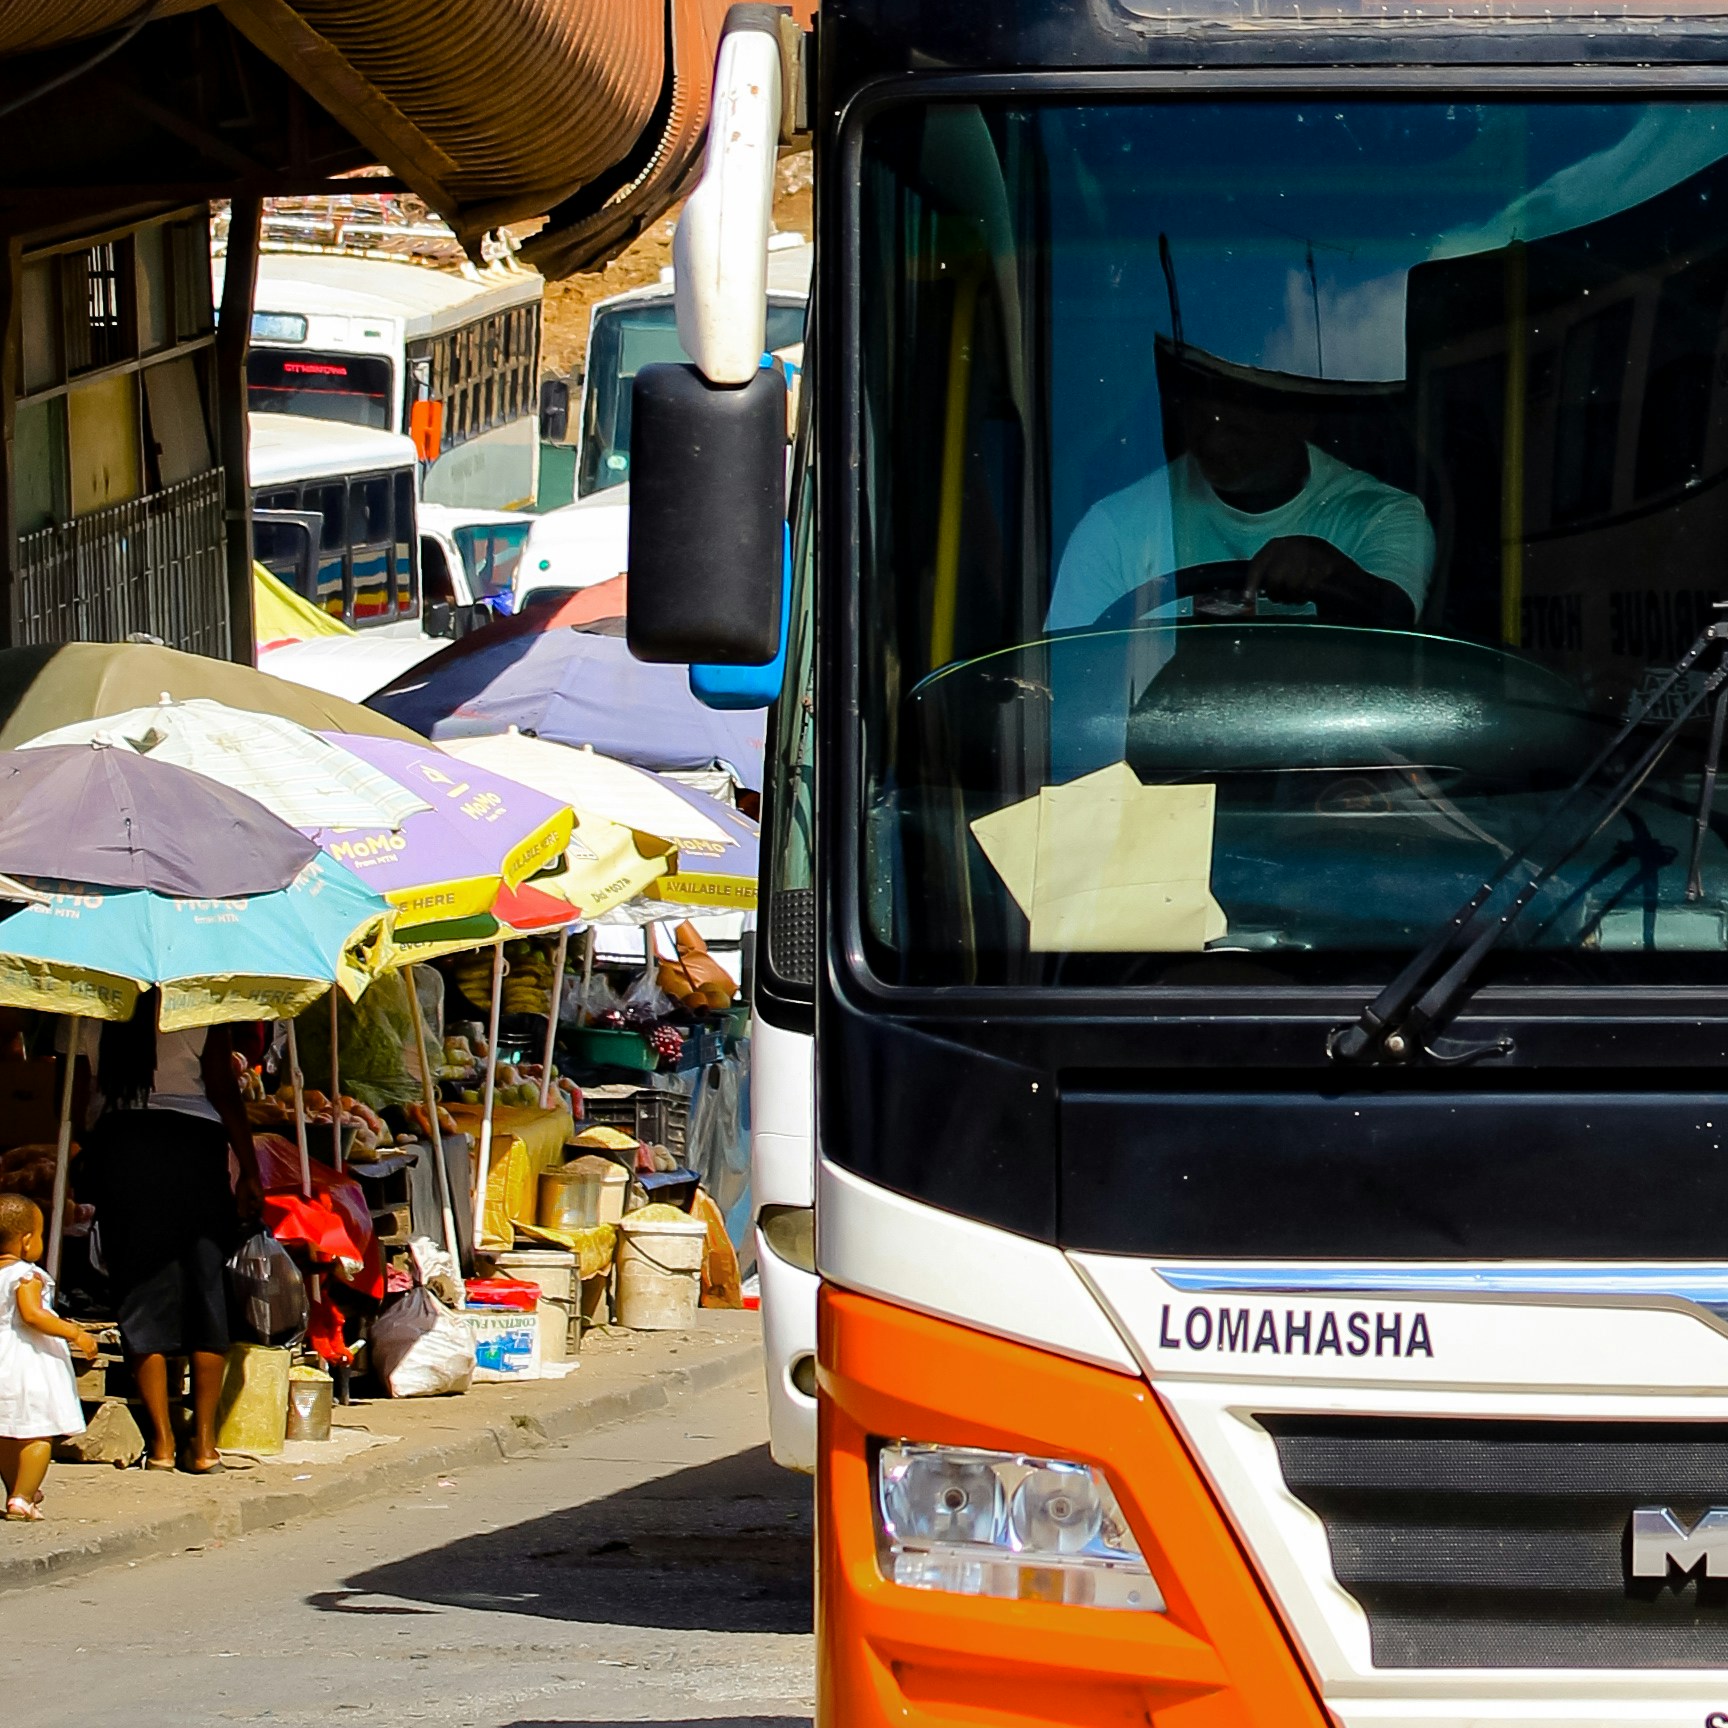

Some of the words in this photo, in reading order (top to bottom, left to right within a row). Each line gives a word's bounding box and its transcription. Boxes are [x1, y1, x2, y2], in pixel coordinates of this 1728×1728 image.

[330, 834, 407, 861] MoMo
[666, 881, 731, 897] AVAILABLE
[734, 883, 759, 898] HER
[413, 892, 455, 911] HERE
[1159, 1303, 1435, 1358] LOMAHASHA
